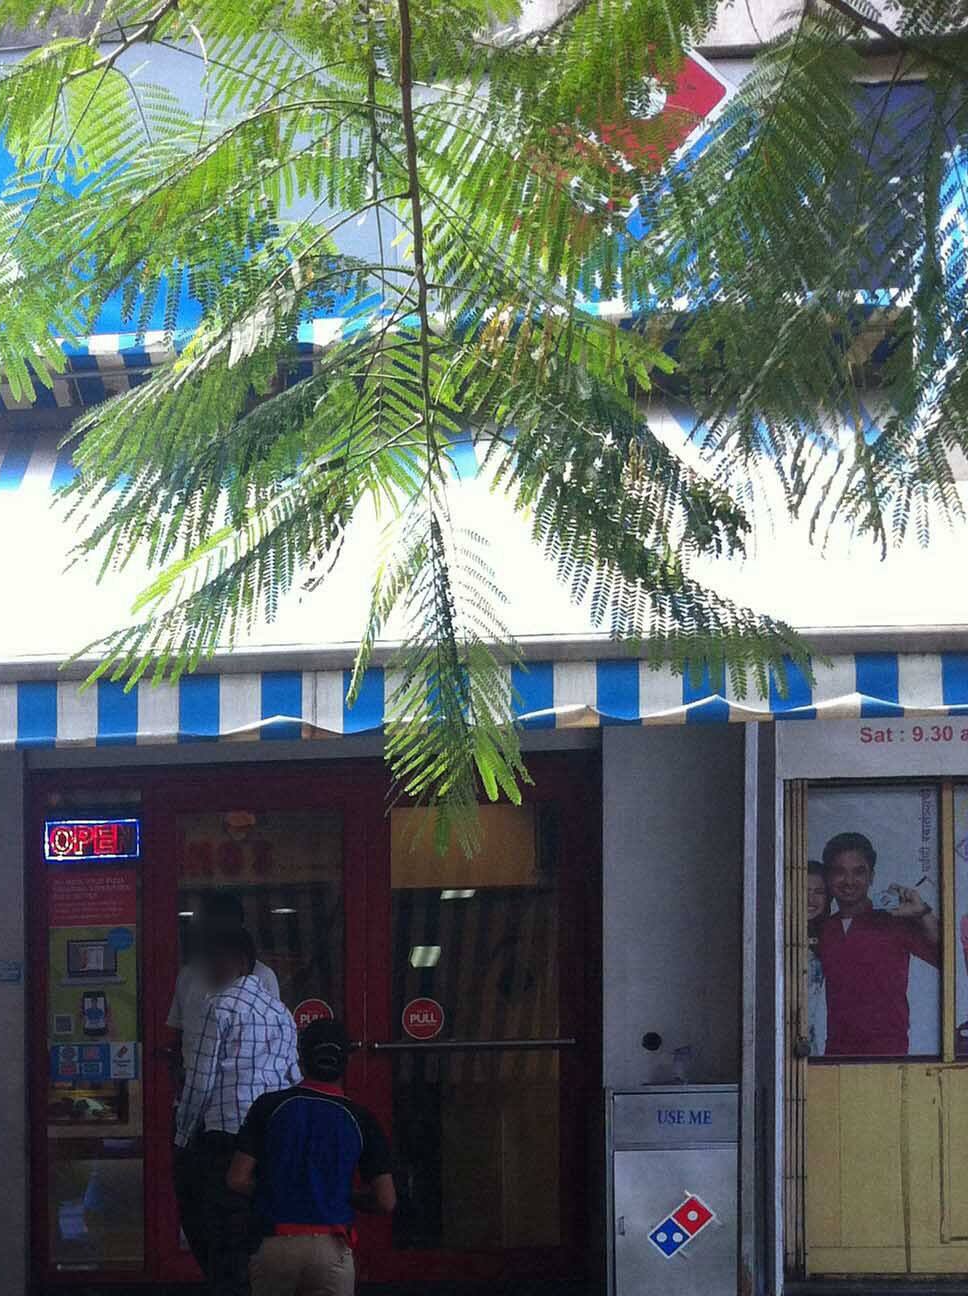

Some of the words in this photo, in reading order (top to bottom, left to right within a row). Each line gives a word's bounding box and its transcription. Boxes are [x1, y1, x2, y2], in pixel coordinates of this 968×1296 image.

[860, 727, 893, 743] Sat
[912, 726, 953, 742] 9.30
[50, 824, 130, 855] OPE
[409, 1013, 437, 1024] PULL
[657, 1110, 685, 1125] USE
[689, 1110, 713, 1125] ME
